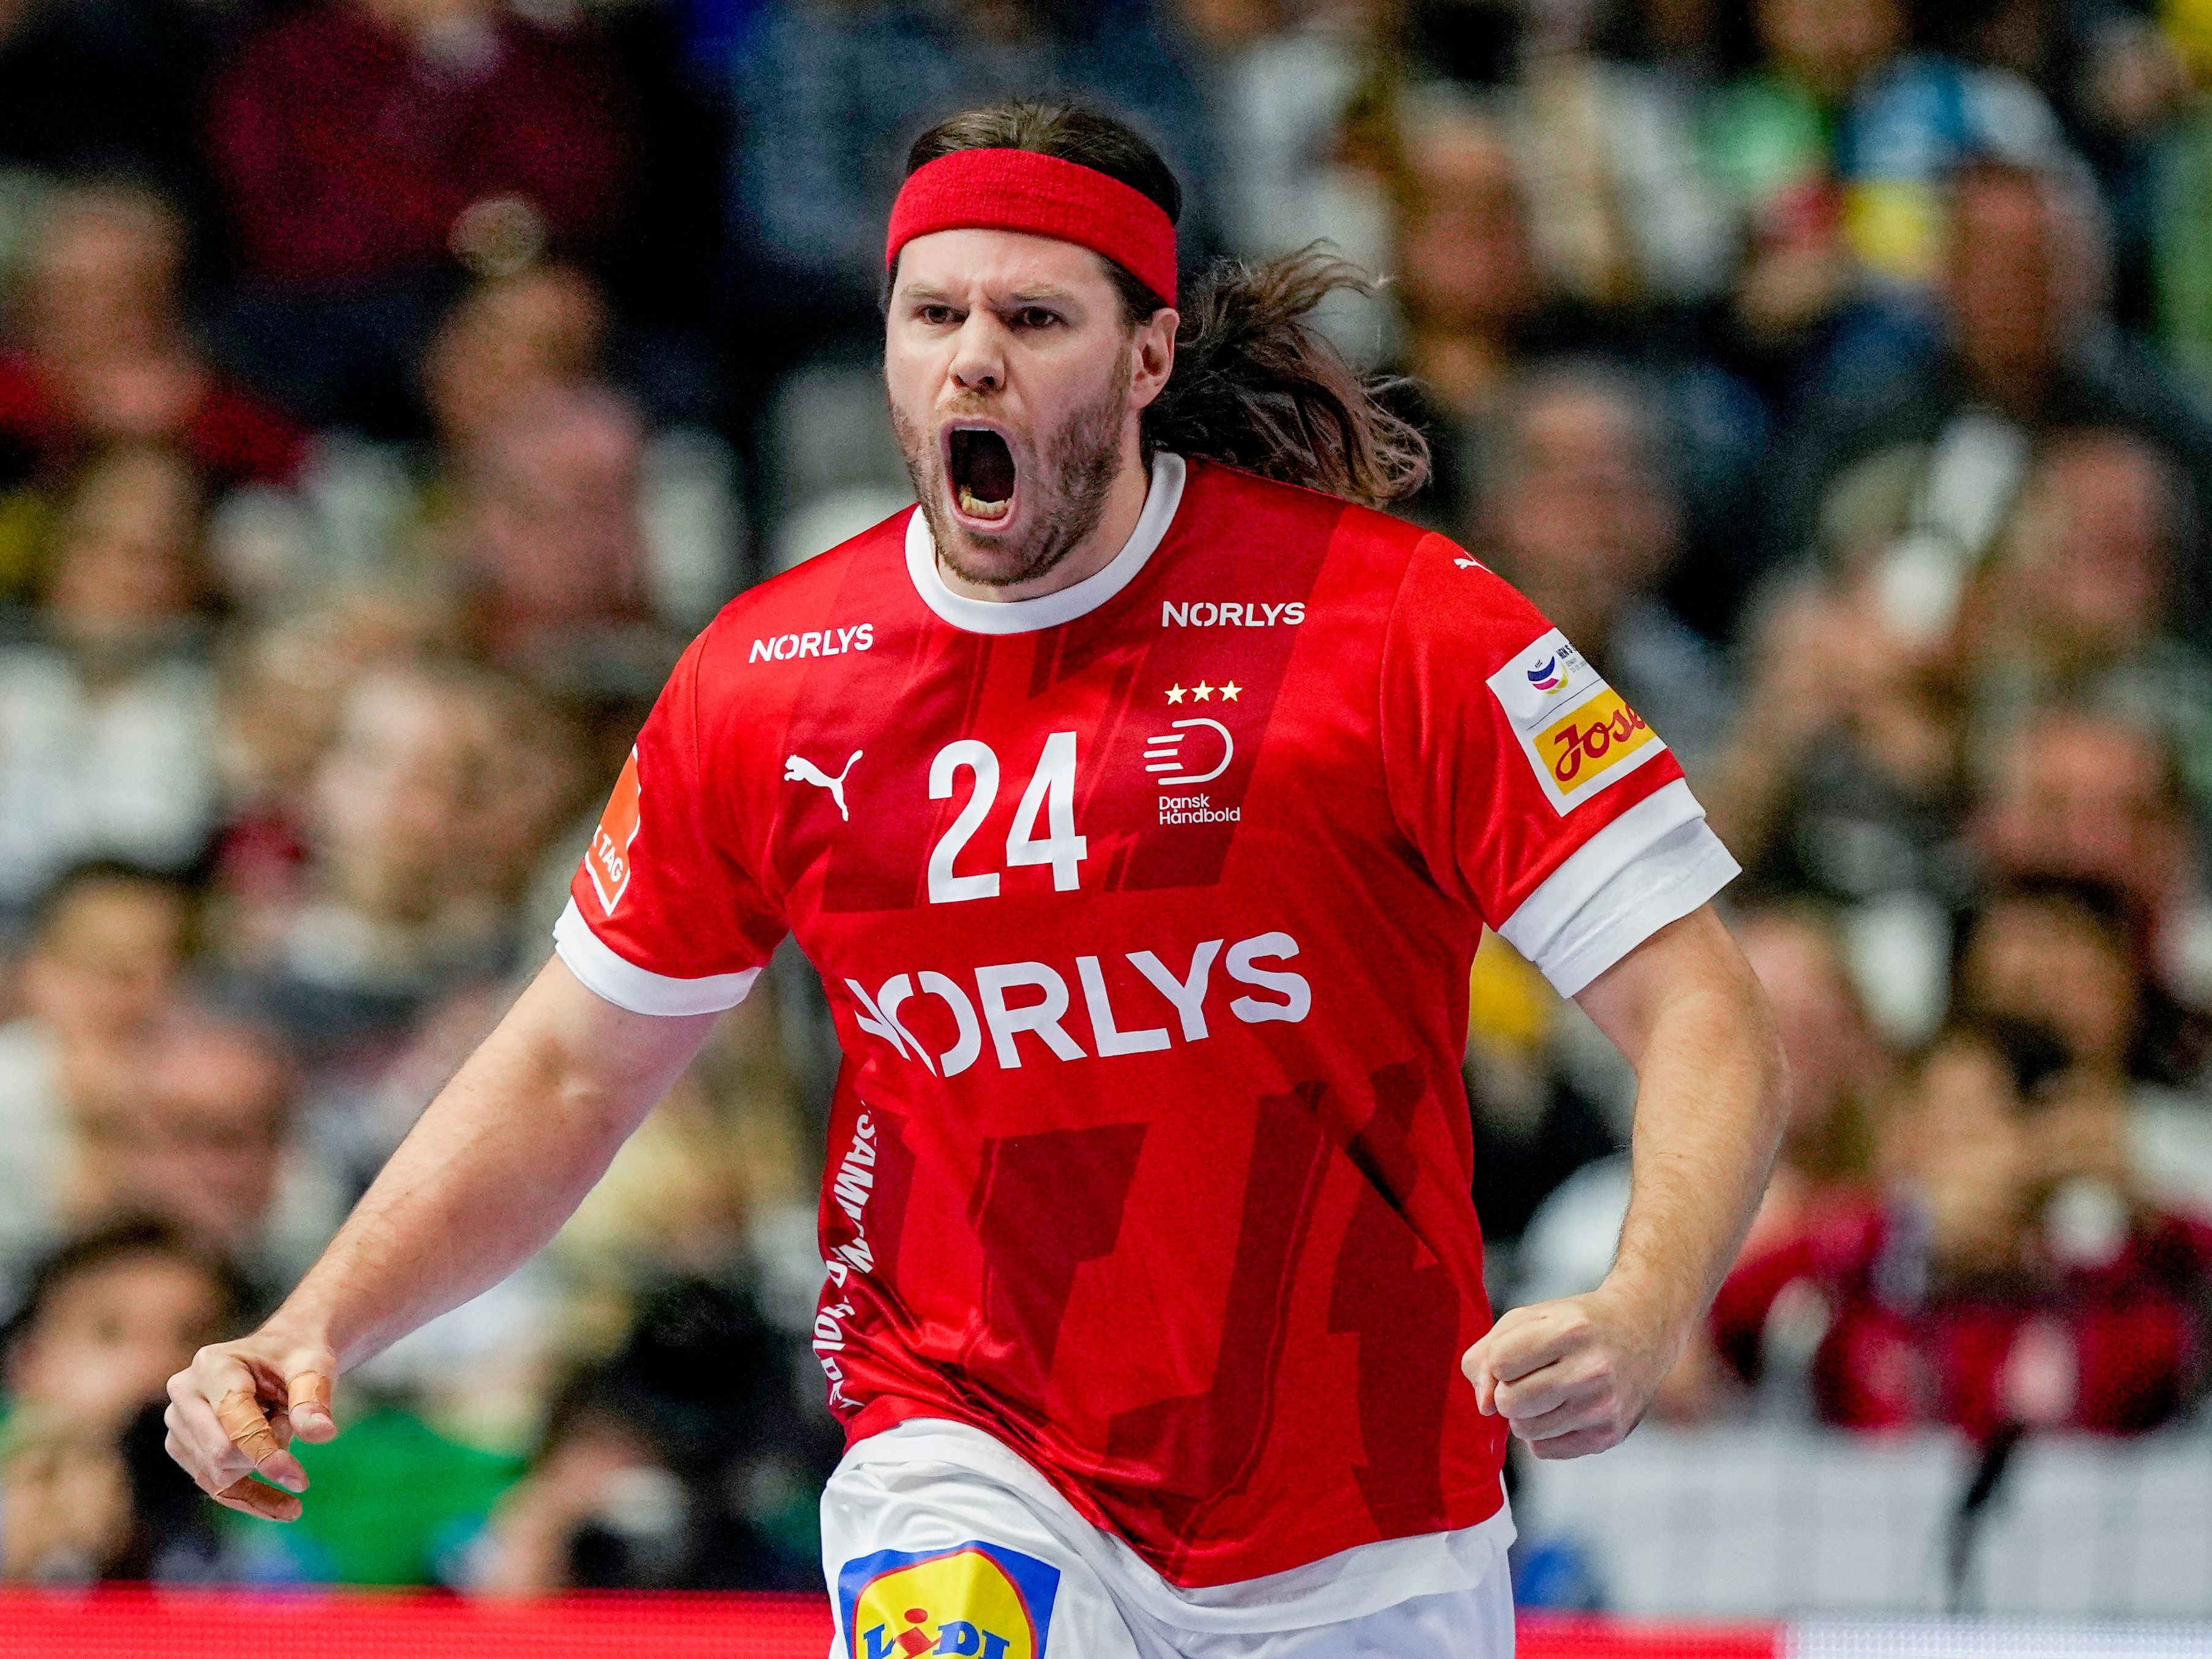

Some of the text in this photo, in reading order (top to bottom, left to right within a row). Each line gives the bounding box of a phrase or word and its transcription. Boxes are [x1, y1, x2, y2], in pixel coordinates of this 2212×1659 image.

[1162, 601, 1306, 628] NORLYS
[748, 623, 874, 663] NORLYS
[928, 731, 1088, 904] 24
[1159, 793, 1210, 810] Dansk
[1159, 807, 1240, 825] Håndbold
[598, 833, 623, 882] TAG
[844, 931, 1312, 1078] NORLYS
